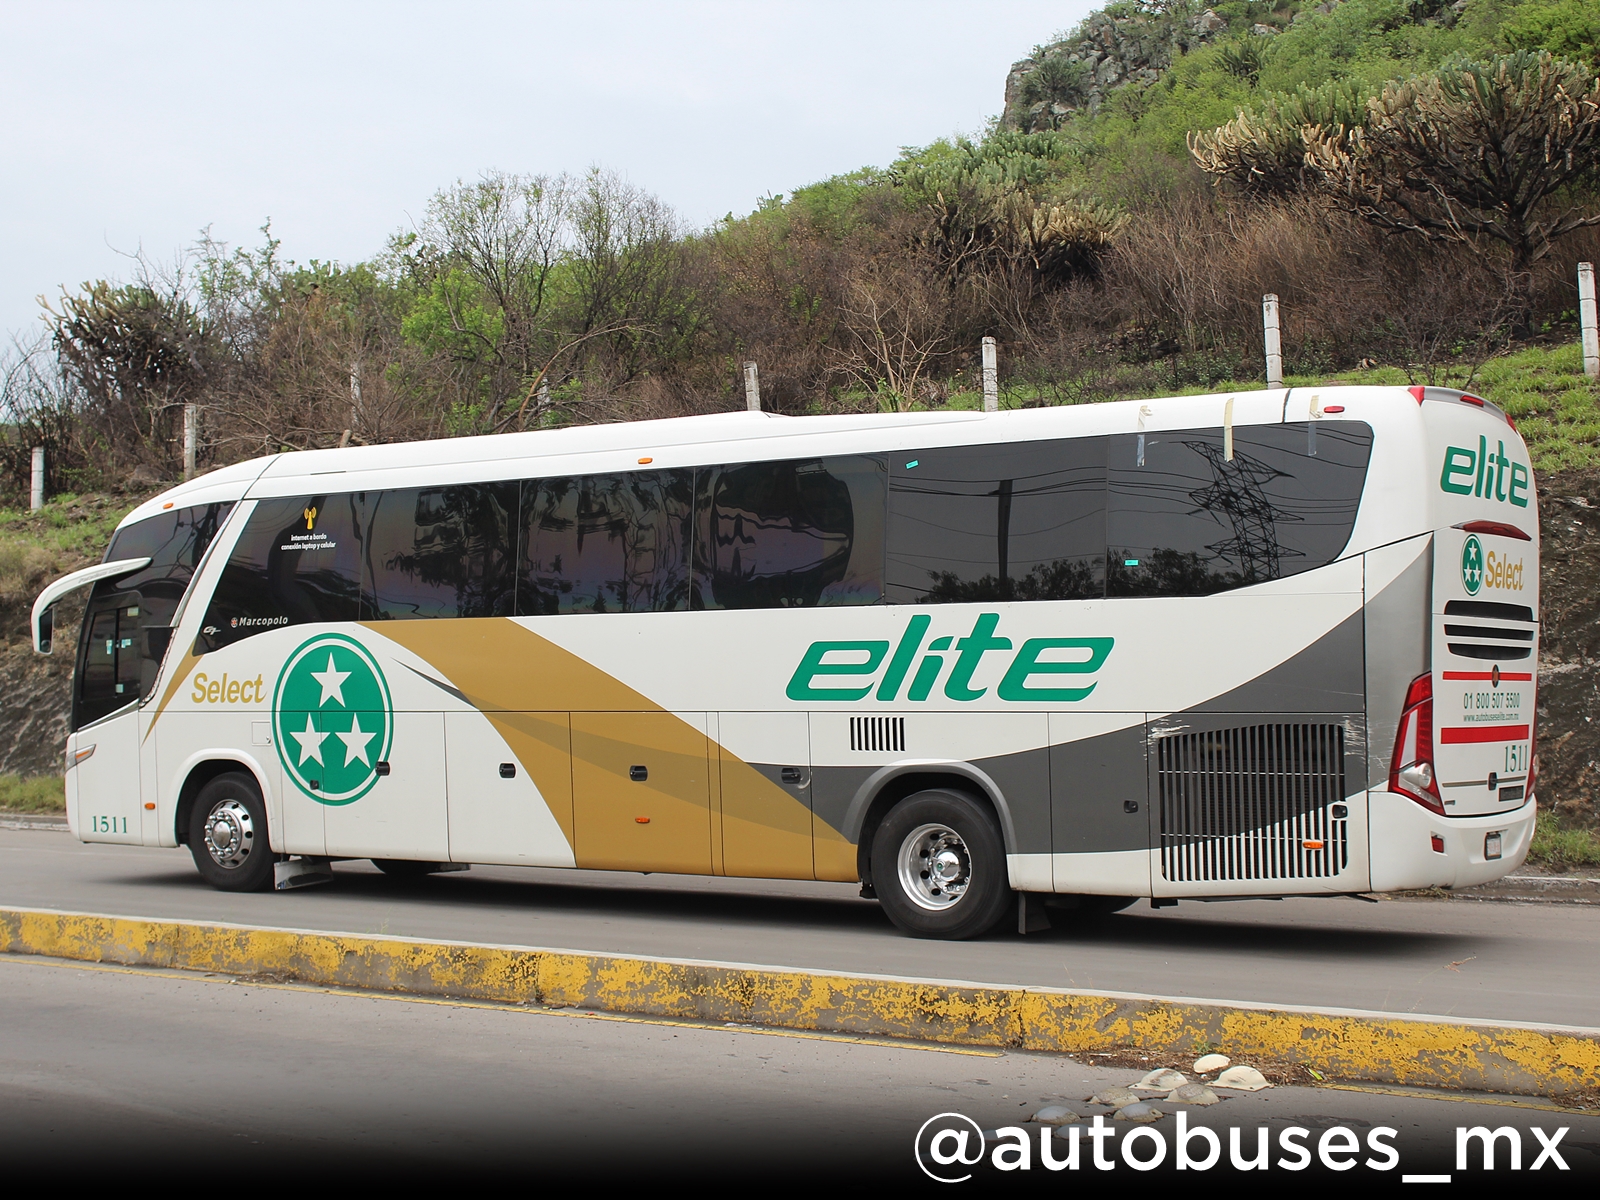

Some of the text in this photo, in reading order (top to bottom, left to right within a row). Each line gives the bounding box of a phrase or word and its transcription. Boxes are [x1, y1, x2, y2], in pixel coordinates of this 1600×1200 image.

[1440, 434, 1528, 509] elite
[1485, 550, 1524, 591] Select
[238, 615, 289, 627] Marcopolo
[785, 612, 1115, 702] elite
[191, 672, 268, 704] Select
[1463, 692, 1521, 710] 01 800 507 5500
[1504, 744, 1528, 773] 1511
[91, 815, 129, 834] 1511
